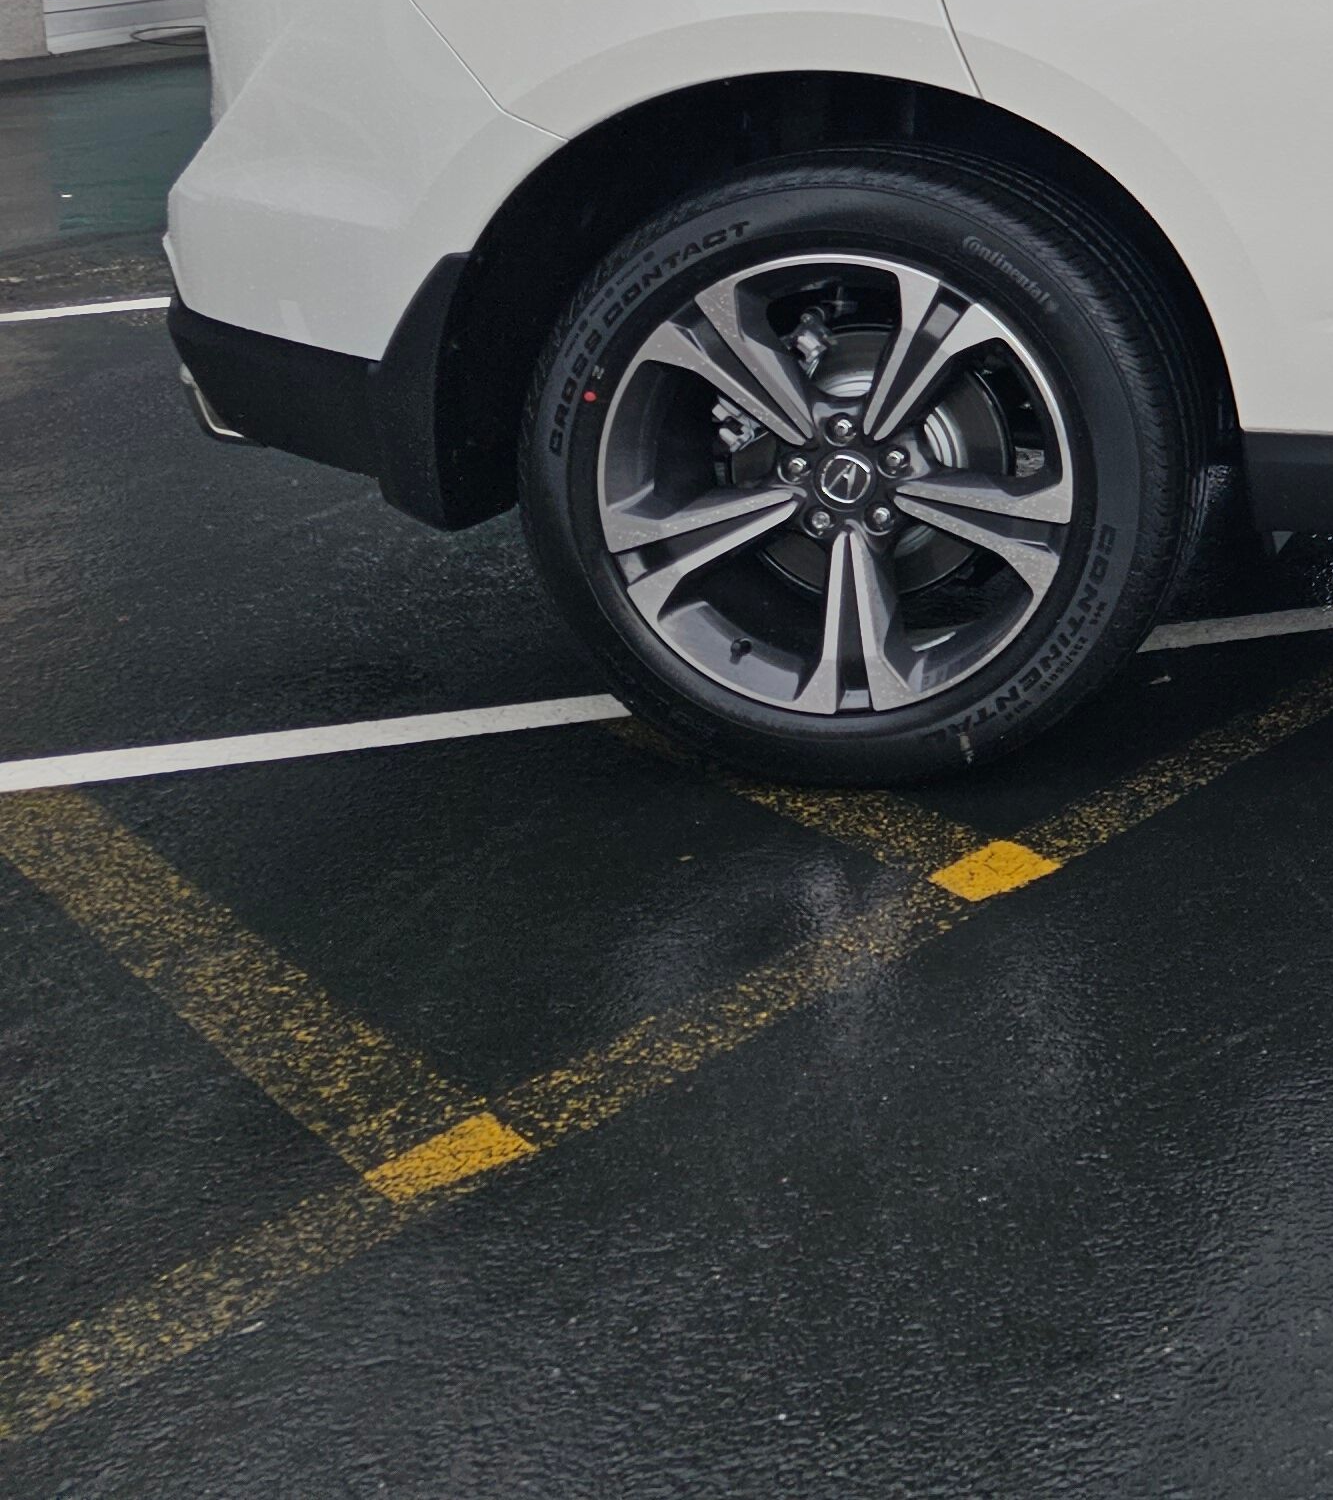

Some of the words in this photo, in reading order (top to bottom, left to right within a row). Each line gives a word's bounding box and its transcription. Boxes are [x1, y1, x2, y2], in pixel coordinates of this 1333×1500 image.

[549, 331, 603, 457] CROSS
[603, 220, 751, 327] CONTACT
[925, 523, 1117, 743] CONTINENTAL
